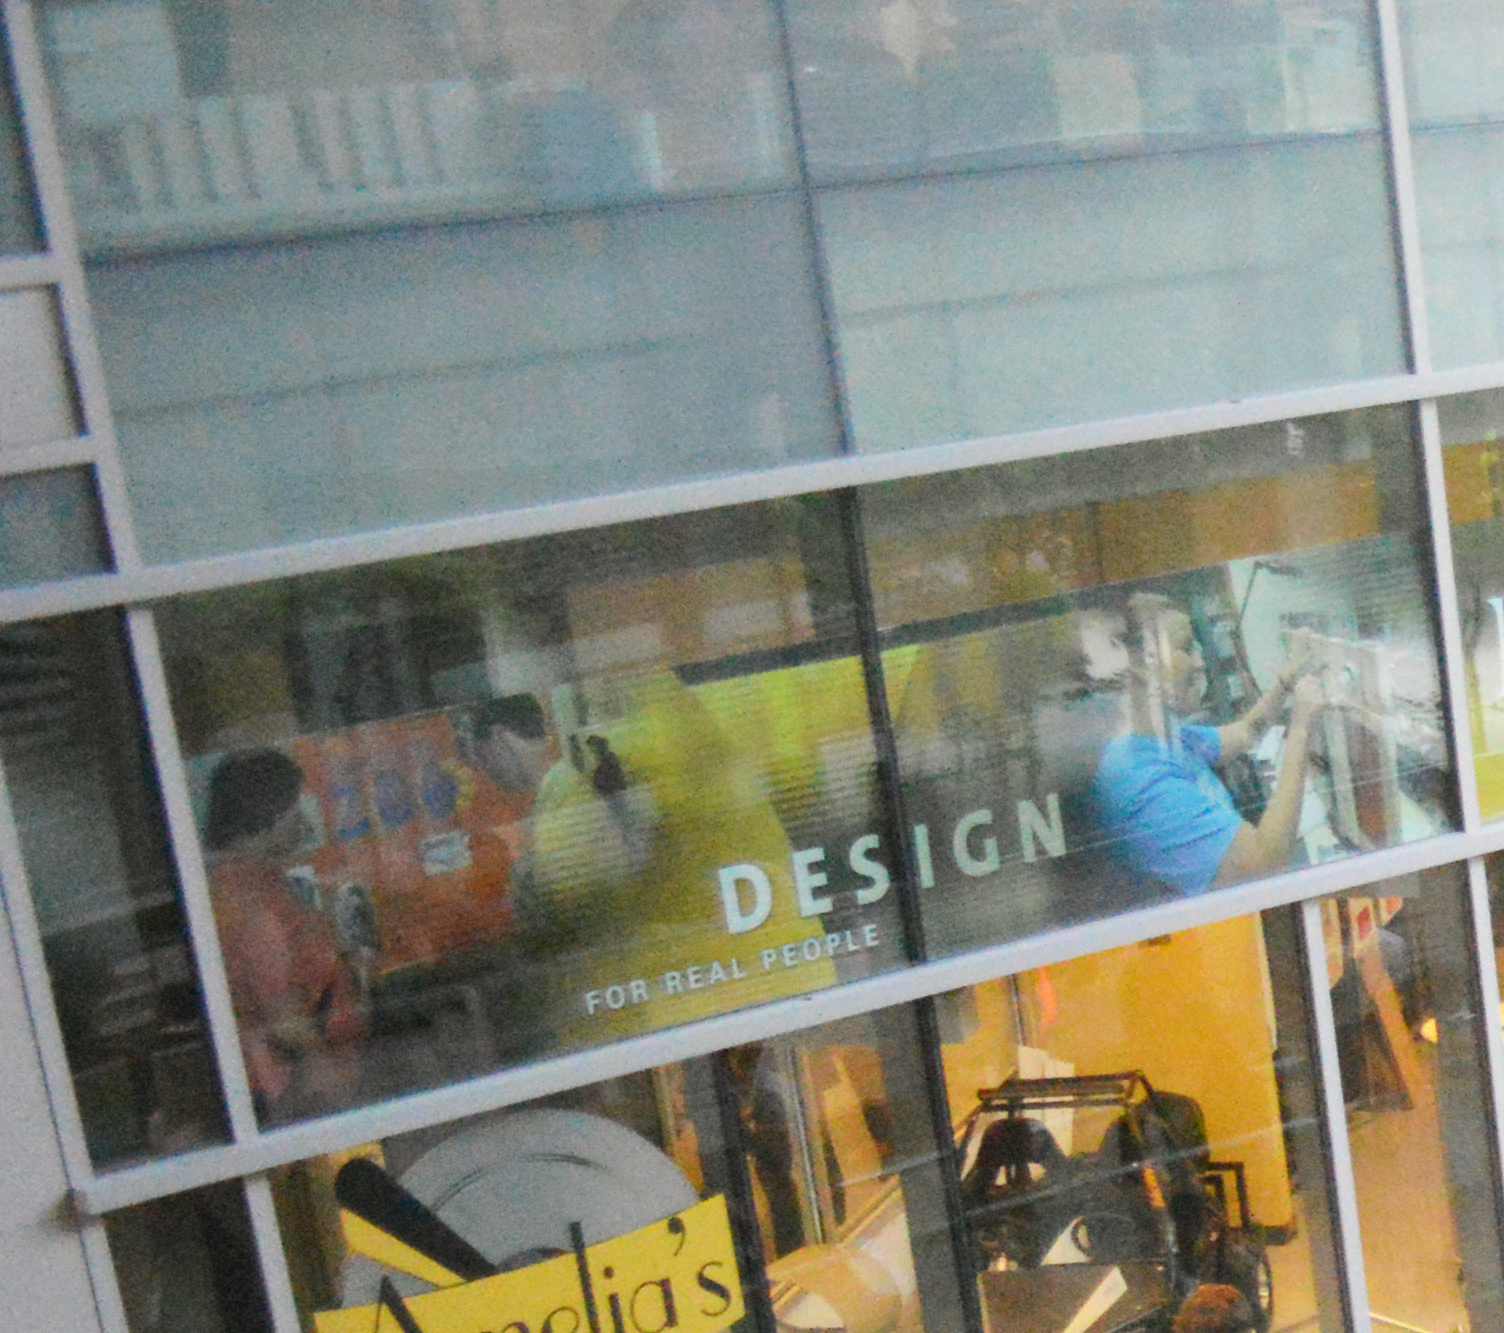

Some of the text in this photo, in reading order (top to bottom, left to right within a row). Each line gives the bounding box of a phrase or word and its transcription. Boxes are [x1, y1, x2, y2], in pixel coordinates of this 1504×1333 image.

[717, 793, 1067, 935] DESIGN
[585, 923, 880, 1017] FOR REAL PEOPLE
